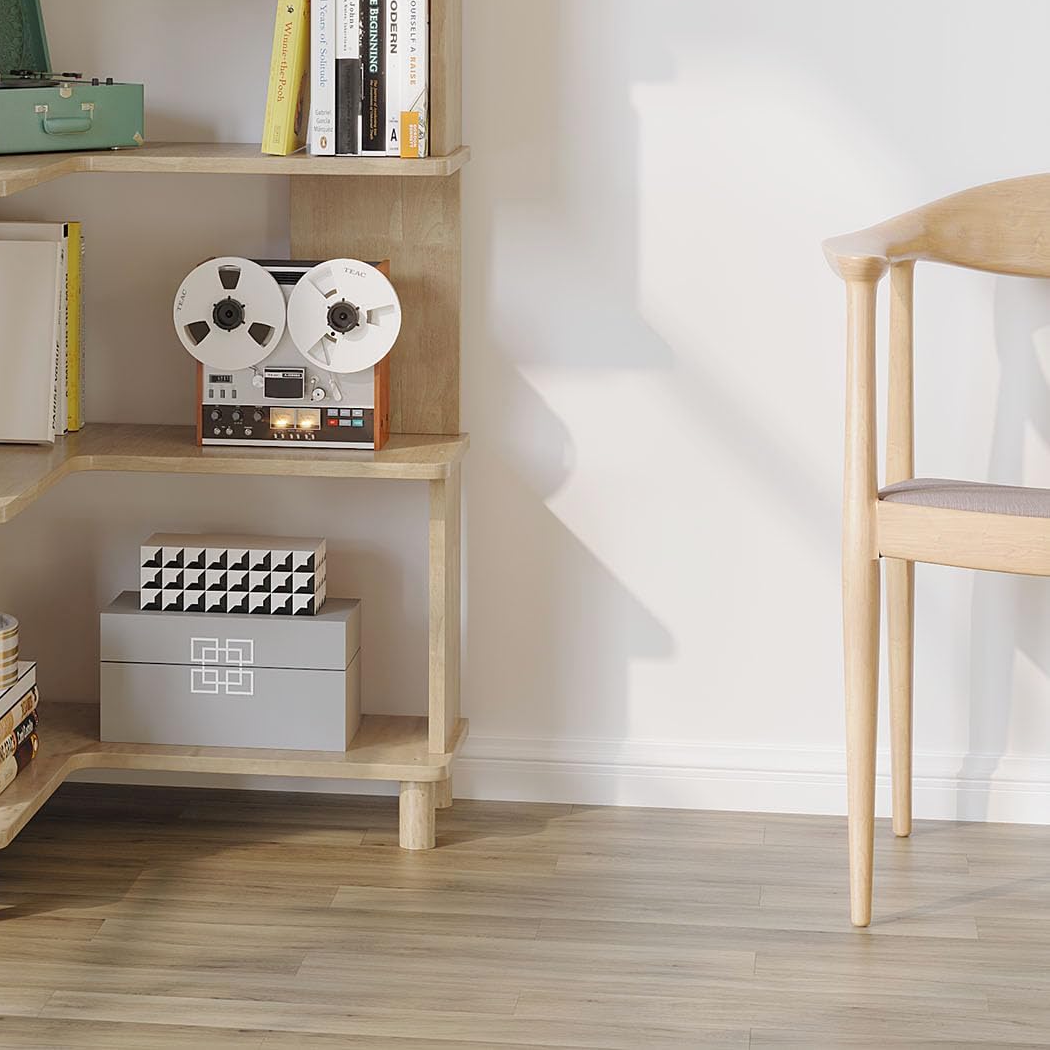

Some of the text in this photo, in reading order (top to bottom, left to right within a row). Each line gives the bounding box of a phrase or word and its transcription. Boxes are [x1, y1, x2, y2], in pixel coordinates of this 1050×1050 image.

[319, 4, 328, 30] Years
[349, 1, 357, 29] Johns
[319, 33, 328, 44] of
[369, 7, 379, 73] BEGINNING
[276, 22, 294, 103] Winnie-the-Pooh
[319, 48, 328, 88] Solitude
[390, 128, 398, 142] A
[343, 266, 367, 278] TEAC
[176, 289, 188, 311] TEAC
